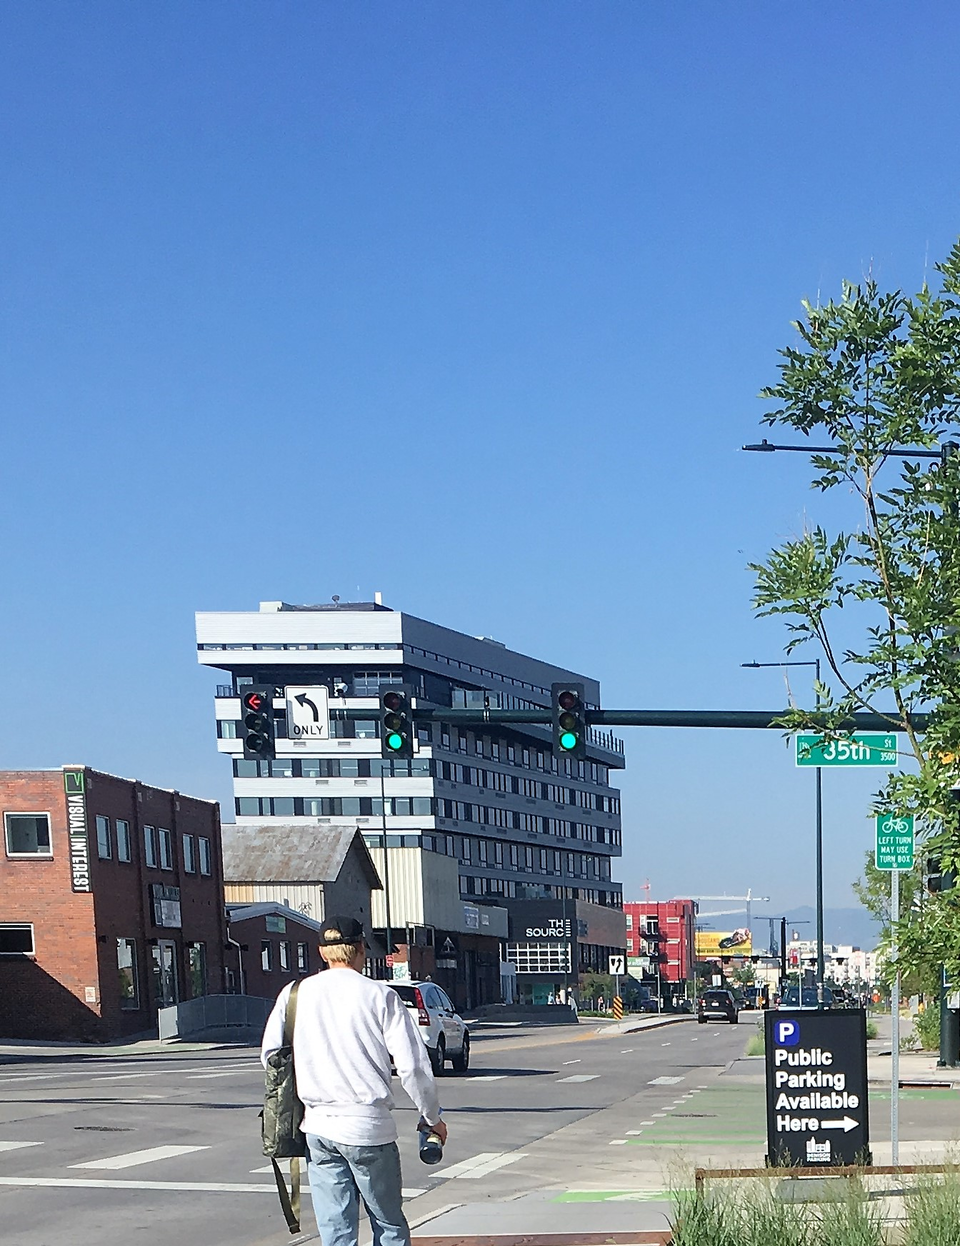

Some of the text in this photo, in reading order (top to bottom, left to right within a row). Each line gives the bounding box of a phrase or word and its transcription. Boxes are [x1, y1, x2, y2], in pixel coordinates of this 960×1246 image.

[293, 725, 323, 735] ONLY
[884, 738, 892, 748] St
[823, 740, 871, 761] 35th
[880, 752, 896, 762] 3500
[67, 795, 90, 892] VISUAL INTEREST
[878, 836, 912, 845] LEFT TURN
[880, 846, 895, 854] MAY
[879, 855, 910, 863] TURN BOX
[548, 919, 571, 928] THE
[525, 928, 571, 938] SOURCE
[779, 1022, 795, 1043] P
[775, 1048, 833, 1067] Public
[775, 1070, 845, 1091] Parking
[775, 1092, 859, 1110] Available
[776, 1114, 820, 1132] Here
